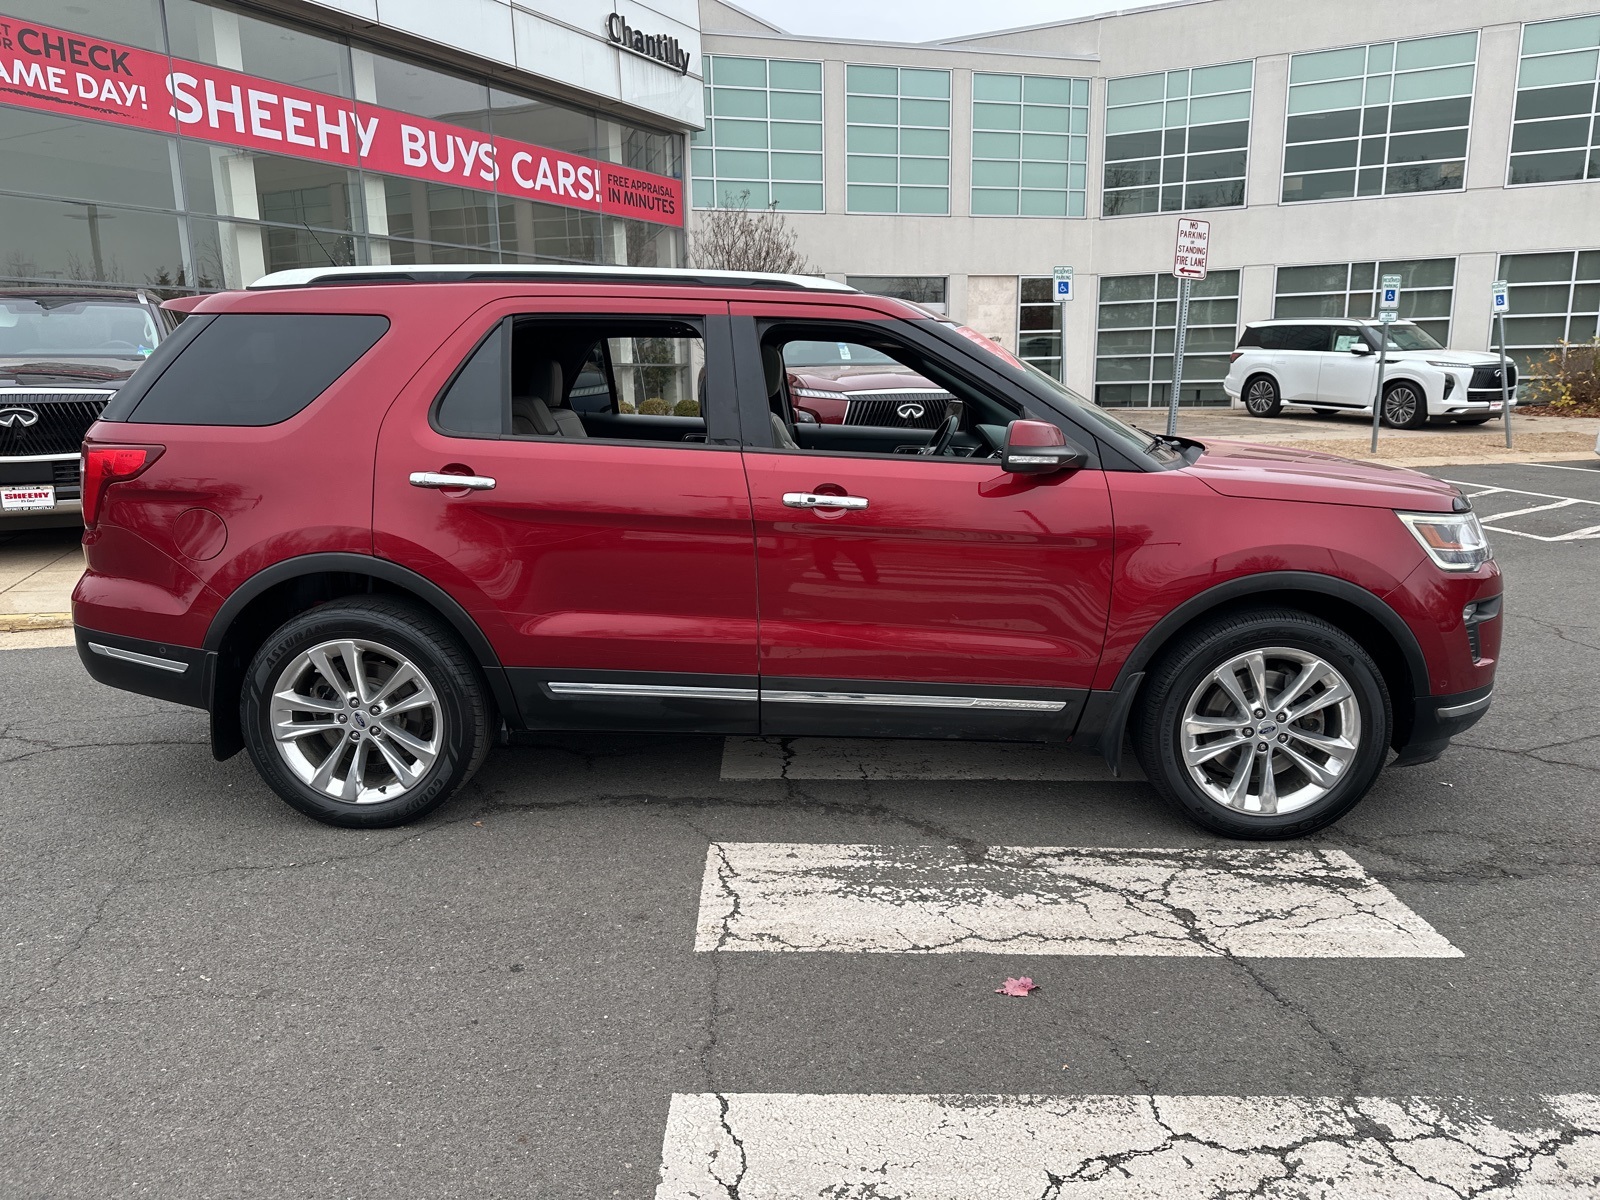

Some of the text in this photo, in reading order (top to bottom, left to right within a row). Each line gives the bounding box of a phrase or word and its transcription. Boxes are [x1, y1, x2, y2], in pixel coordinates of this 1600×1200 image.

[18, 28, 133, 76] CHECK
[606, 12, 690, 76] Chantilly
[76, 73, 148, 110] DAY!
[165, 72, 603, 203] SHEEHY BUYS CARS!
[607, 174, 675, 199] FREE APPRAISAL
[608, 188, 675, 215] IN MINUTES
[1178, 245, 1206, 255] STANDING
[1180, 230, 1207, 240] PARKING
[1176, 255, 1205, 267] FIRE LANE
[265, 621, 338, 669] ASSURAN
